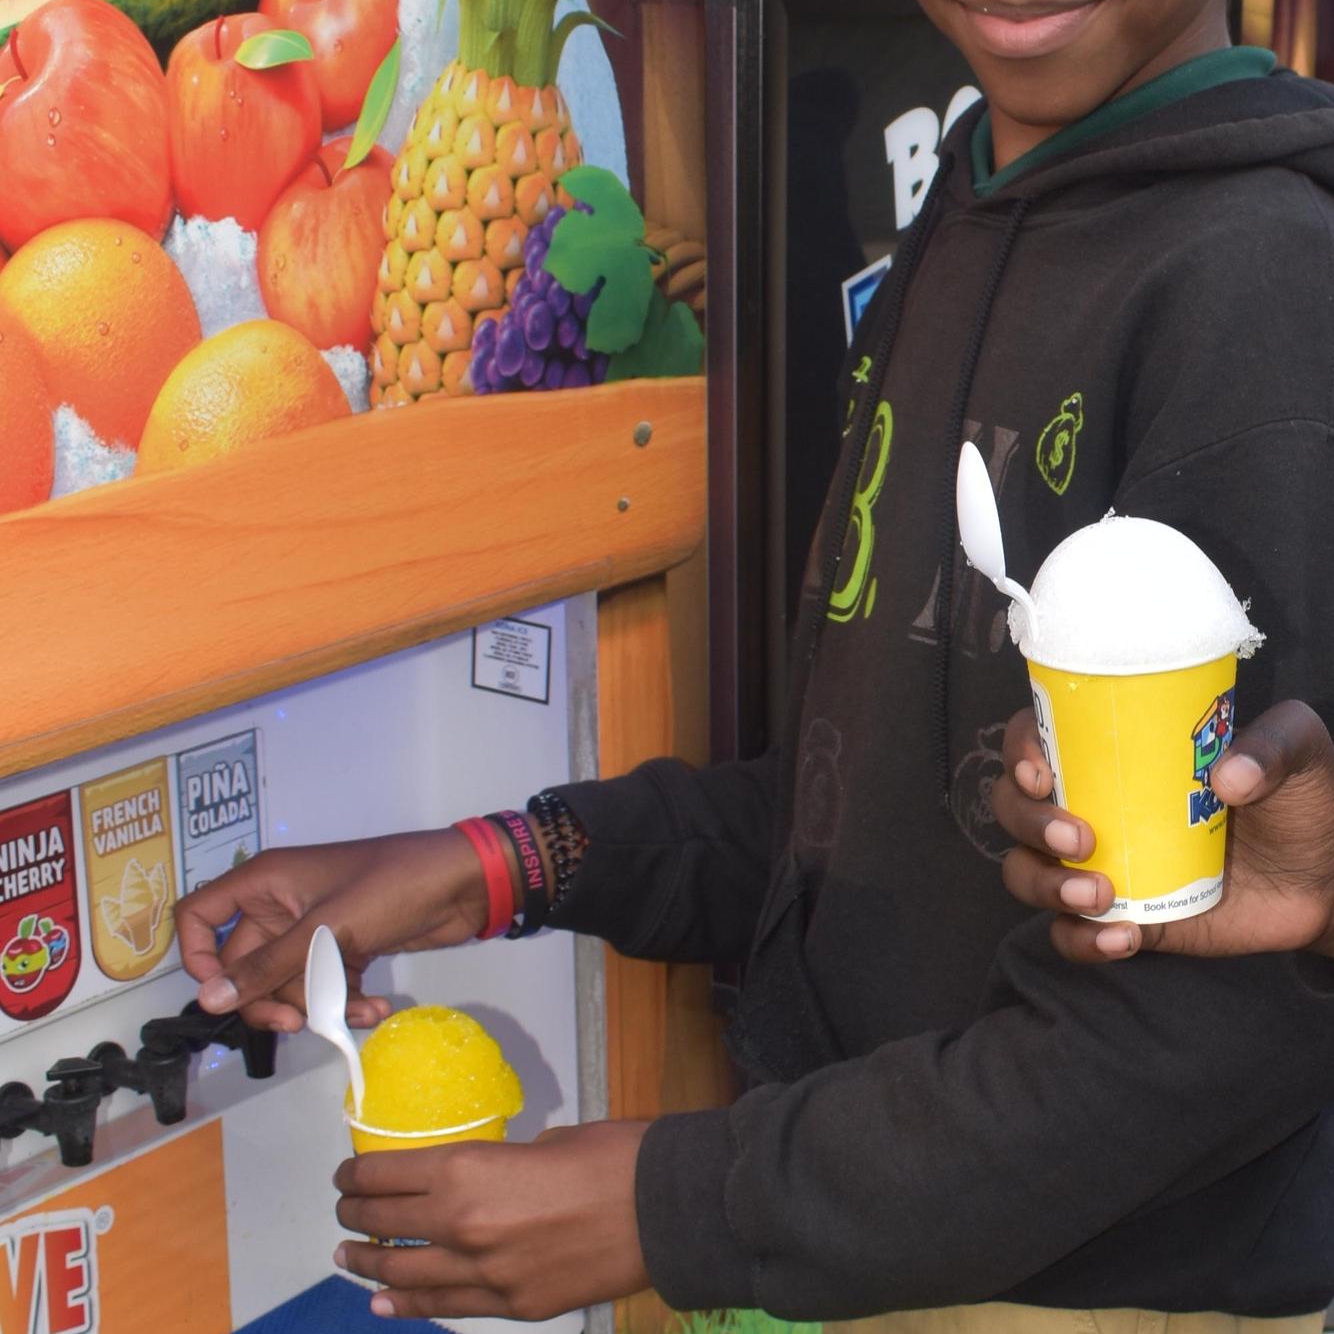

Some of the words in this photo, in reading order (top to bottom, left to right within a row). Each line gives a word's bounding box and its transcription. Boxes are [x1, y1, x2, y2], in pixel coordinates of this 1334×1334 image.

[187, 759, 250, 812] PIÑA
[91, 788, 161, 834] FRENCH
[188, 795, 251, 838] COLADA
[93, 813, 164, 857] VANILLA
[0, 857, 66, 902] HERRY
[1144, 901, 1167, 913] Book
[1168, 897, 1189, 908] Kona
[1189, 893, 1200, 905] for
[1199, 883, 1218, 901] School
